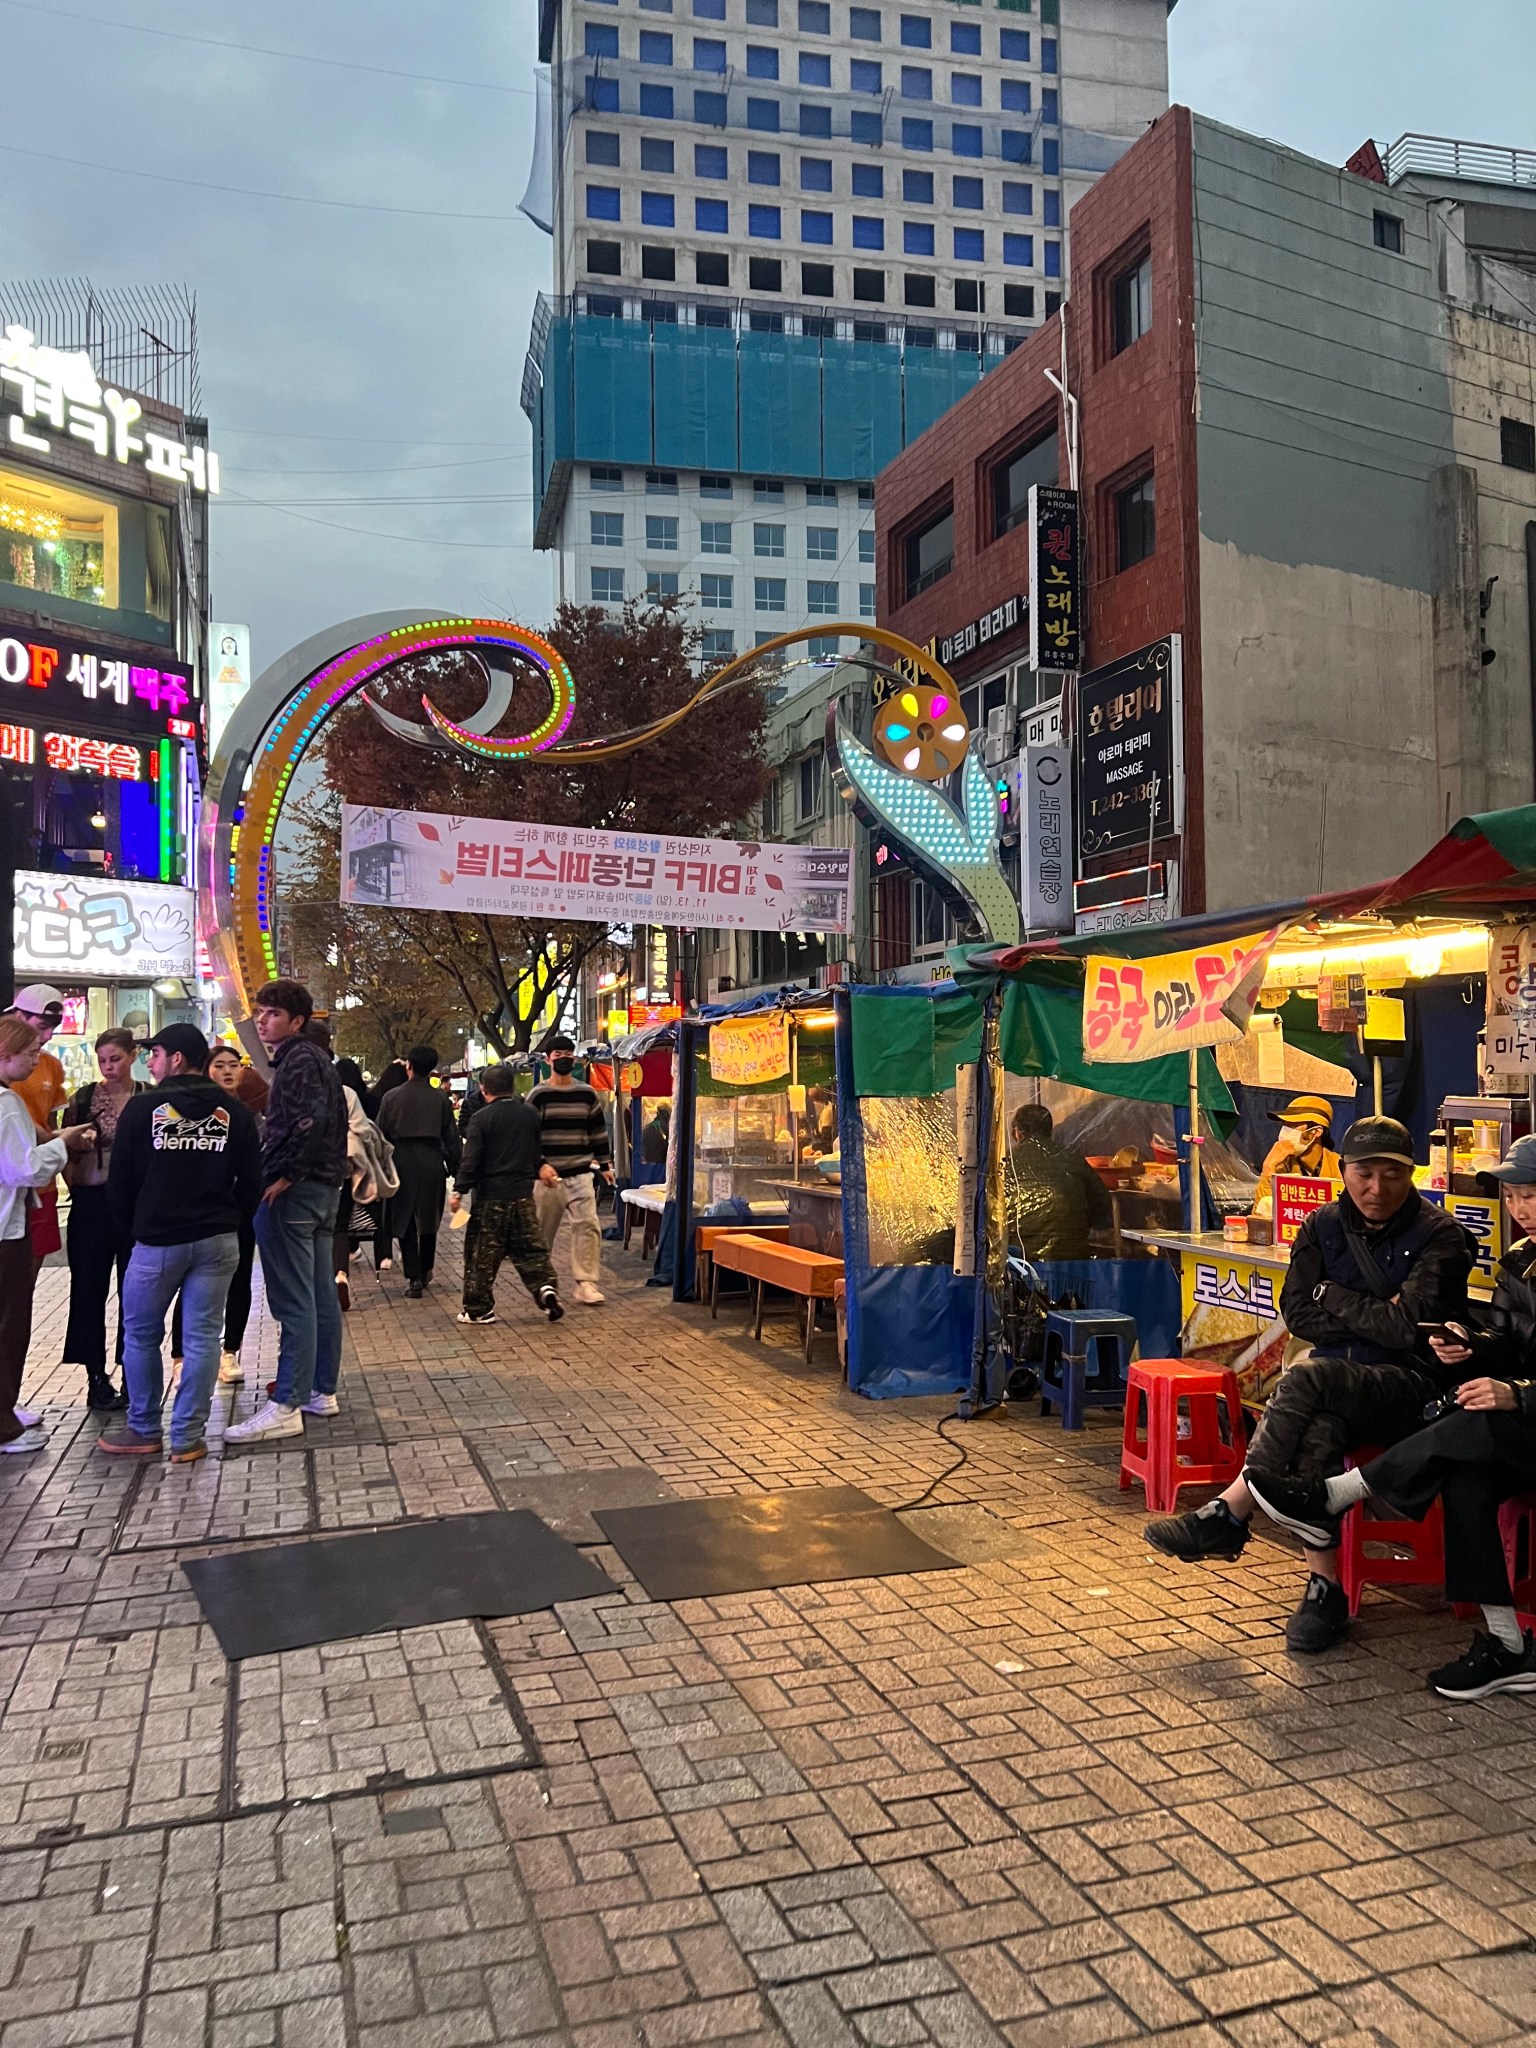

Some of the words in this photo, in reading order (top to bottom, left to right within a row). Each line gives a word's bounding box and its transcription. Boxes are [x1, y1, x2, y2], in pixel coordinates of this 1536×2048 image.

[1053, 500, 1076, 510] ROOM
[942, 626, 977, 664] 아로마
[979, 597, 1018, 643] 테라피
[1044, 565, 1077, 647] 노래방
[66, 653, 190, 715] 세계맥주
[1087, 677, 1162, 738] 호텔리어
[44, 731, 141, 782] 행복을
[1098, 741, 1124, 764] 아로마
[1124, 731, 1151, 755] 테라피
[1106, 760, 1144, 785] MASSAGE
[1039, 789, 1063, 904] 노래연습장
[153, 1132, 228, 1153] element
[1280, 1183, 1327, 1205] 일반토스트
[1193, 1262, 1279, 1321] 토스트
